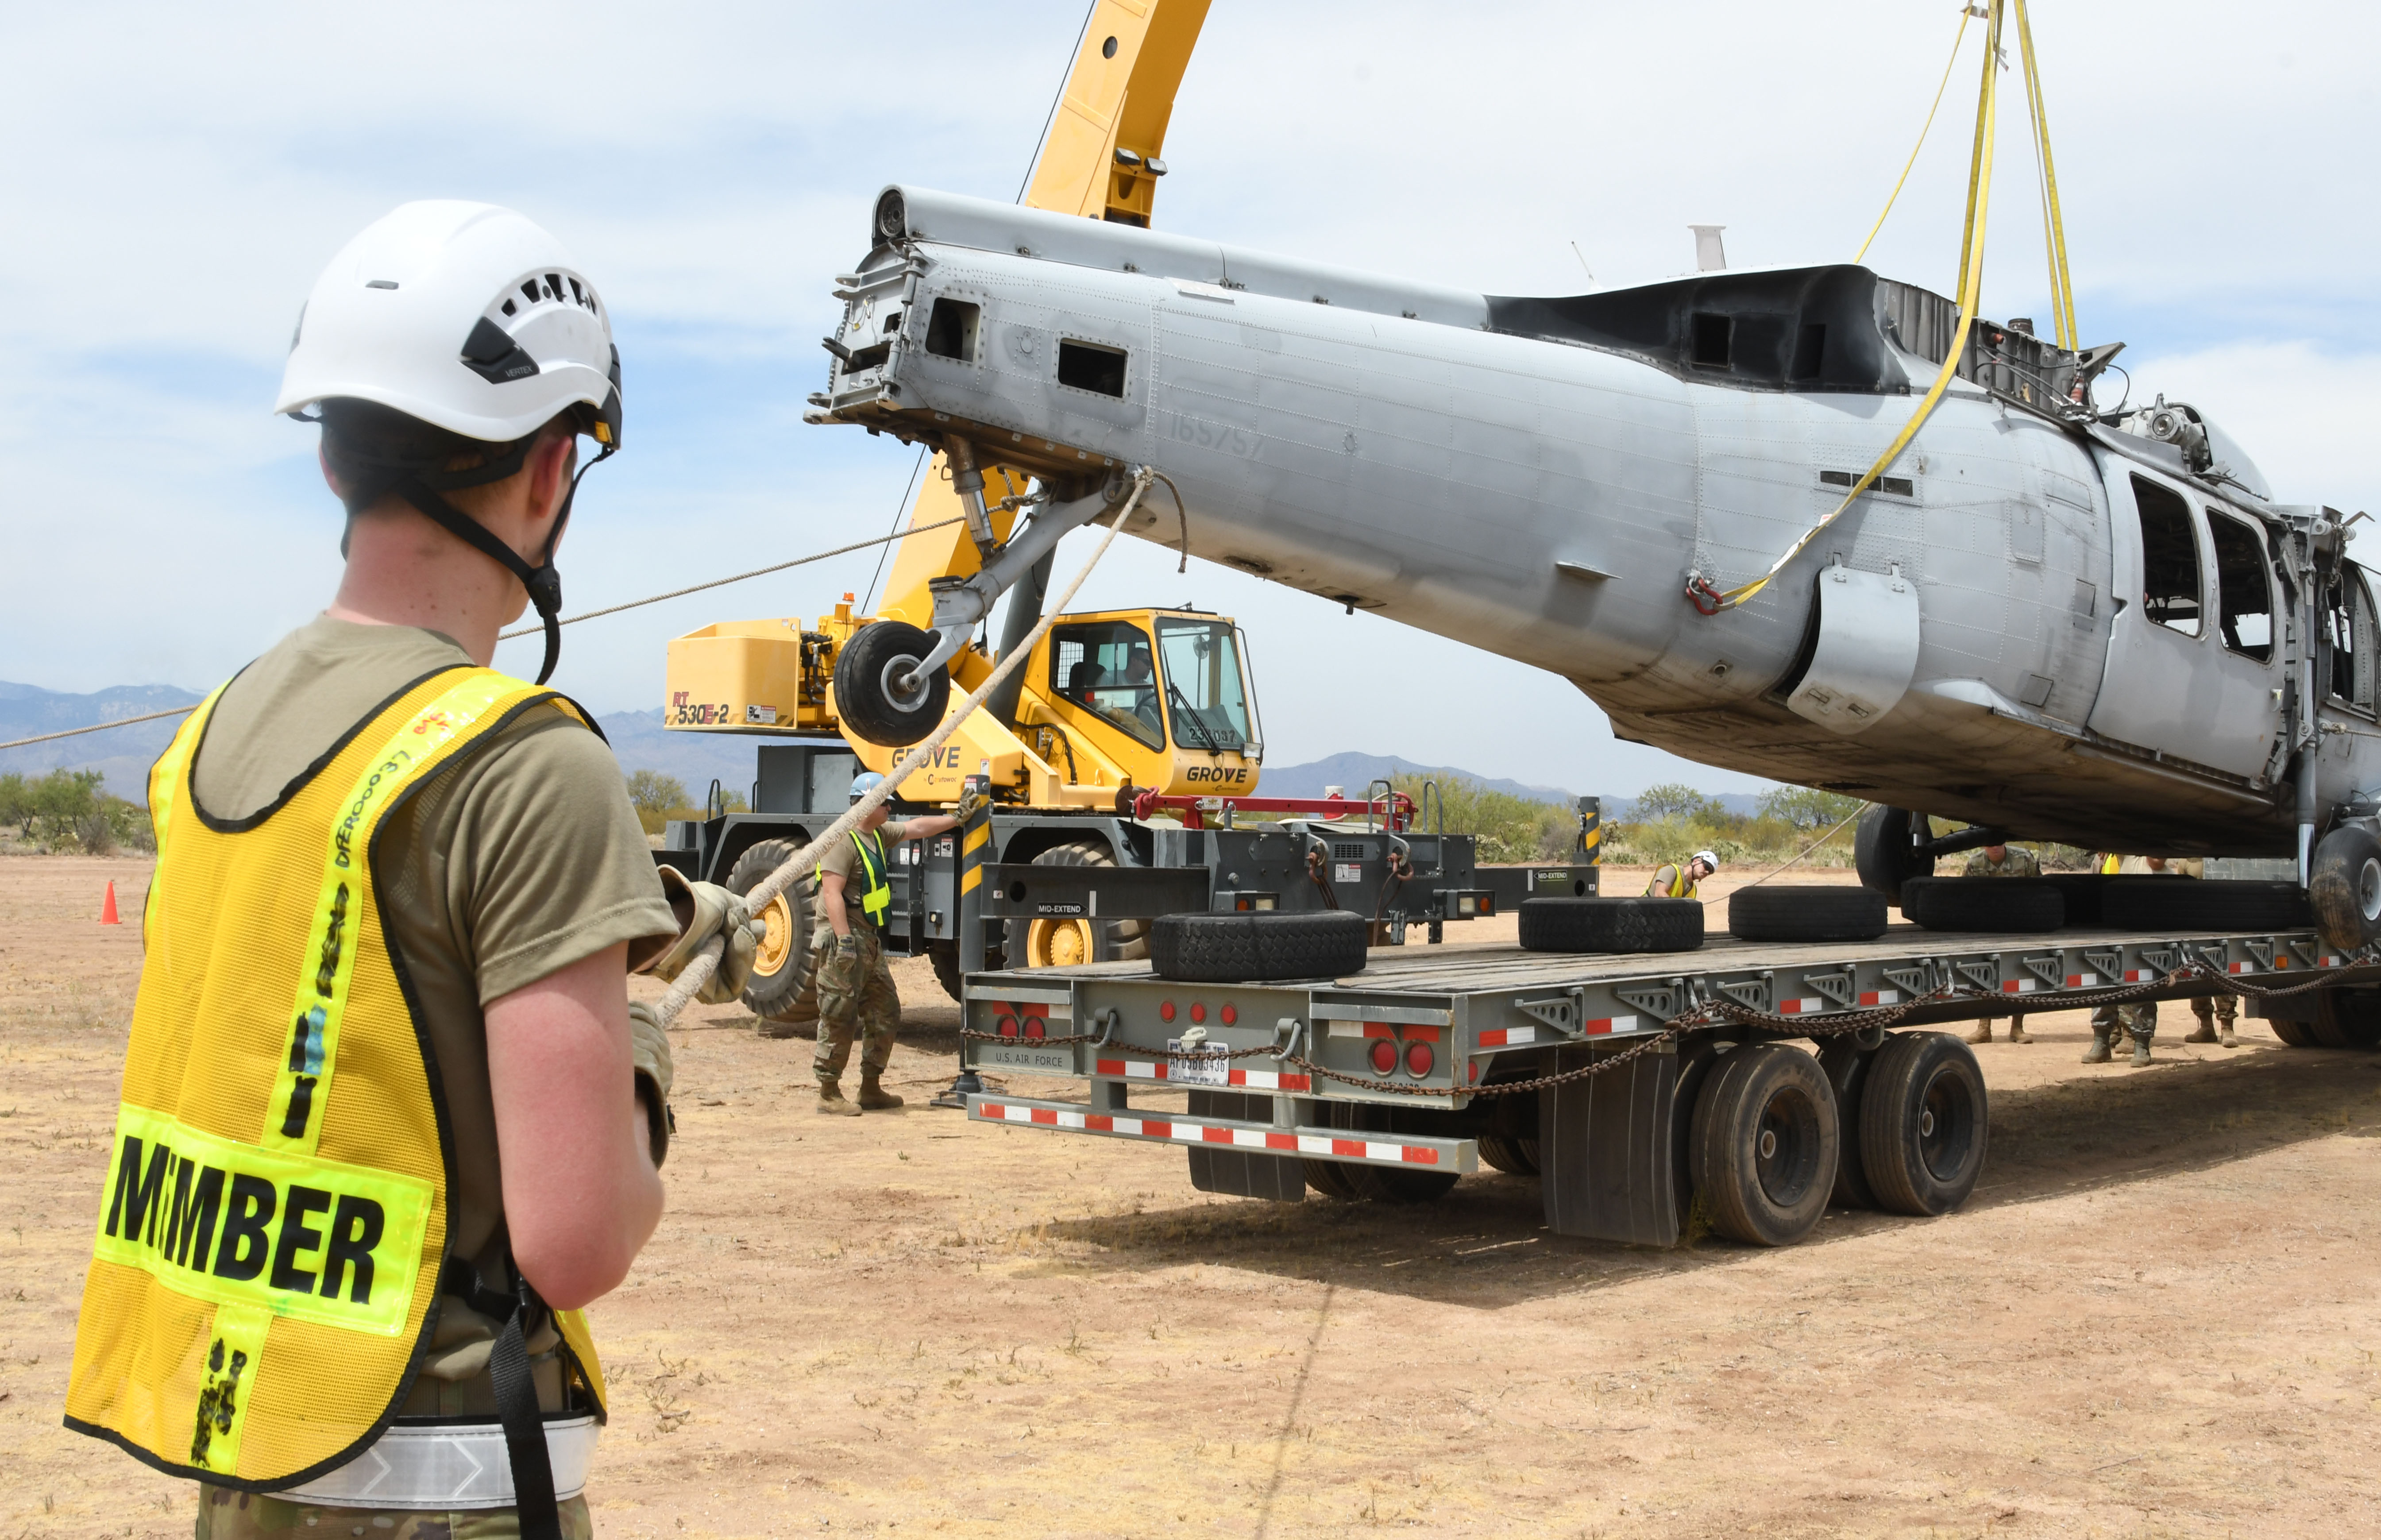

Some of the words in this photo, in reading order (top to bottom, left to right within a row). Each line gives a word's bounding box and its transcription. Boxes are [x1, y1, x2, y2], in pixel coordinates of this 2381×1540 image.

[506, 365, 533, 378] VERTEX
[672, 691, 689, 707] RT
[678, 704, 729, 725] 530E-2
[1187, 766, 1247, 783] GROVE
[996, 1053, 1012, 1062] U.S.
[1015, 1054, 1030, 1064] AIR
[1035, 1055, 1062, 1067] FORCE
[105, 1135, 385, 1305] MMBER
